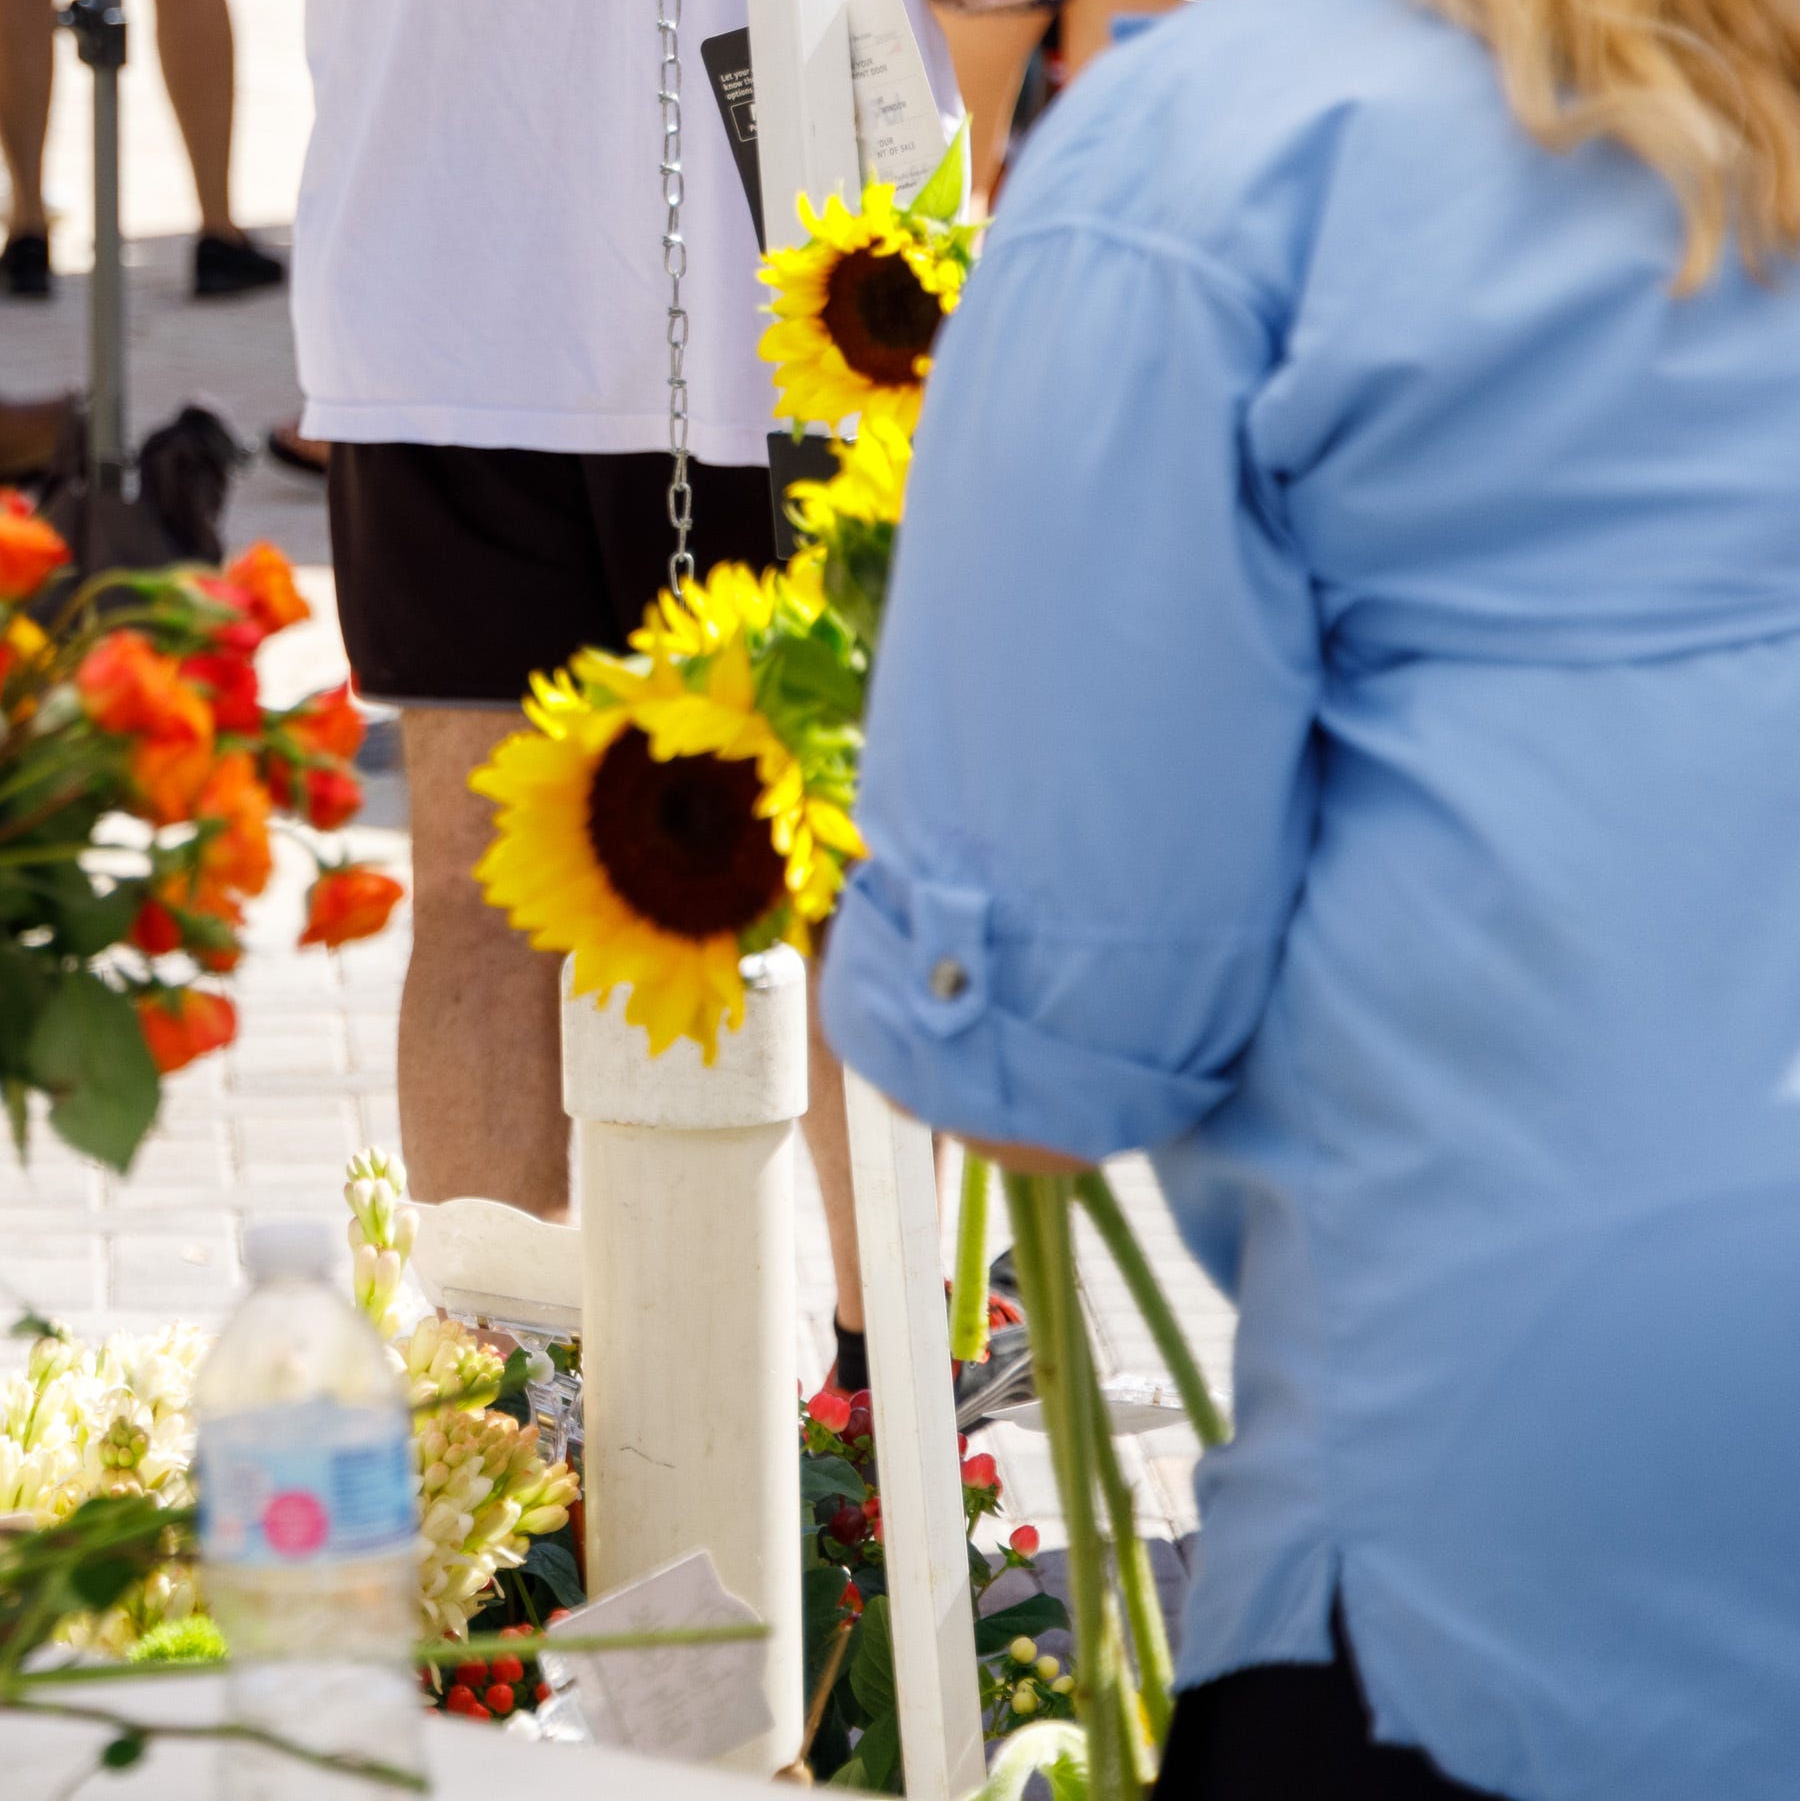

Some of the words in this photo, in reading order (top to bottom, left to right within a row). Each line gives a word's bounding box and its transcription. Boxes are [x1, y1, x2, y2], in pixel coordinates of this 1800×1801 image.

[720, 73, 733, 81] Let
[733, 68, 750, 80] your
[723, 80, 744, 91] know
